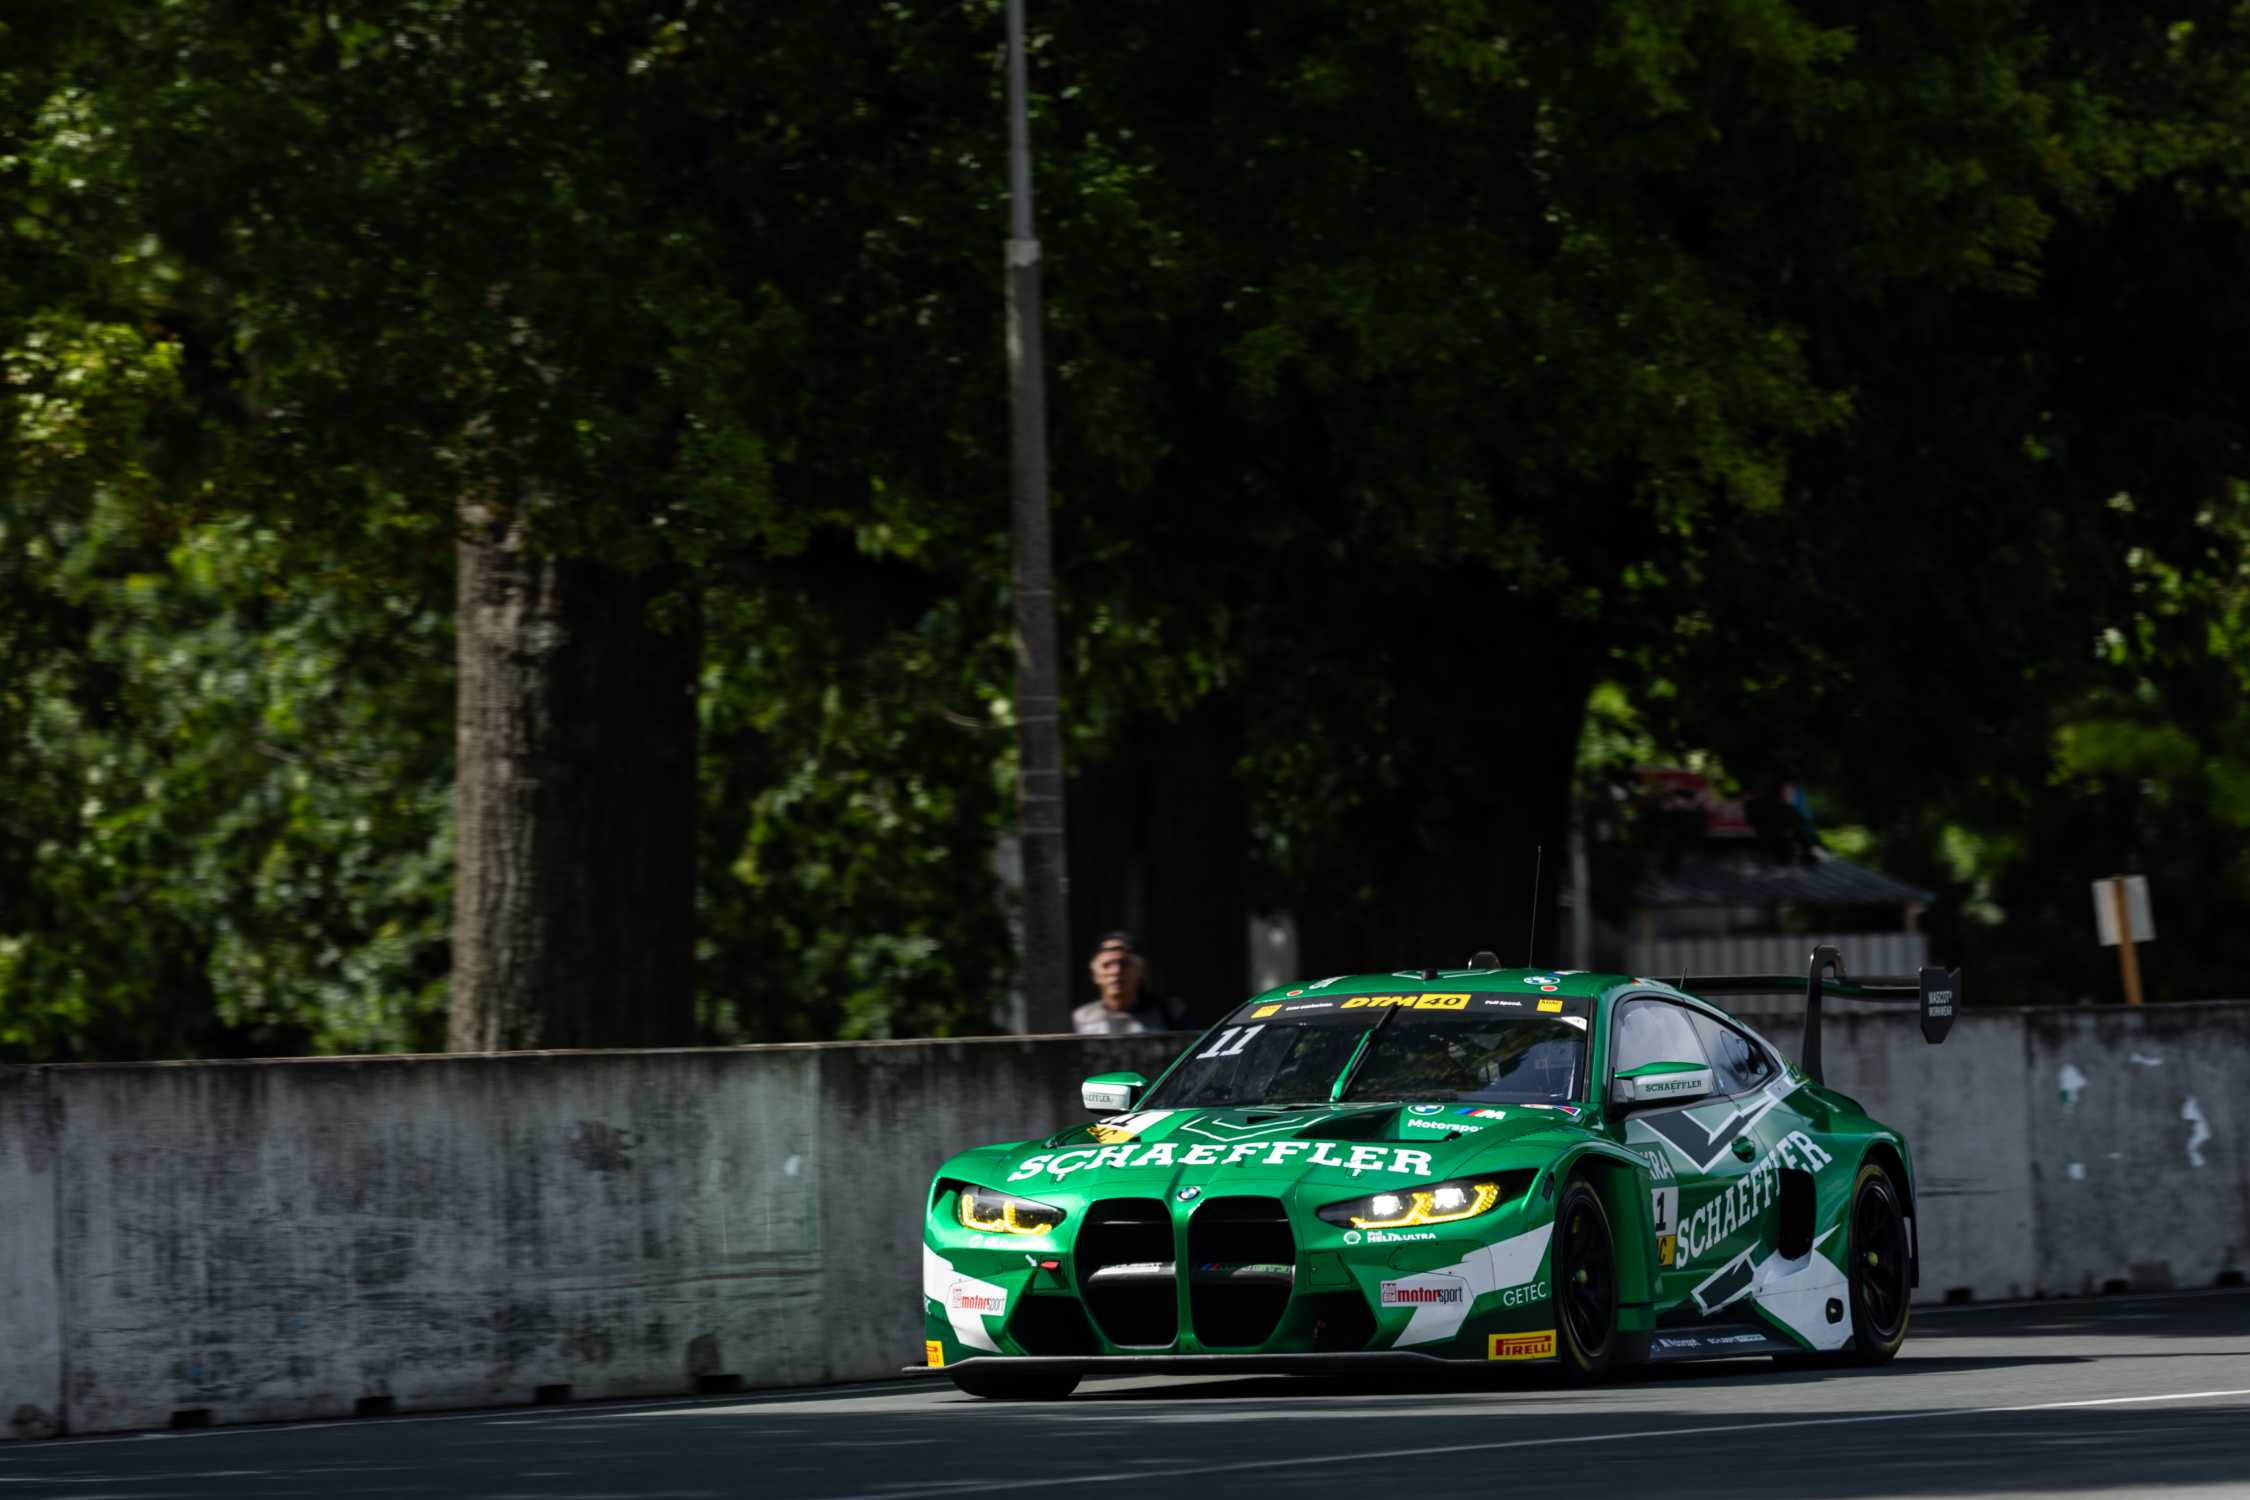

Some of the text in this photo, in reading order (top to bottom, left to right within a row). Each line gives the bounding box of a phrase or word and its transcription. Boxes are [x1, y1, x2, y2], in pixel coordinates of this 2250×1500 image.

[1340, 995, 1418, 1008] DTM
[1423, 997, 1461, 1006] 40
[1195, 1024, 1266, 1059] 11
[1645, 1079, 1702, 1093] SCHAEFFLER
[1408, 1119, 1484, 1133] Motorspo
[1009, 1141, 1432, 1181] SCHAEFFLER
[1403, 1232, 1437, 1241] ULTRA
[1397, 1286, 1463, 1304] motorsport
[1503, 1281, 1547, 1306] GETEC
[1495, 1335, 1552, 1356] PIRELLI
